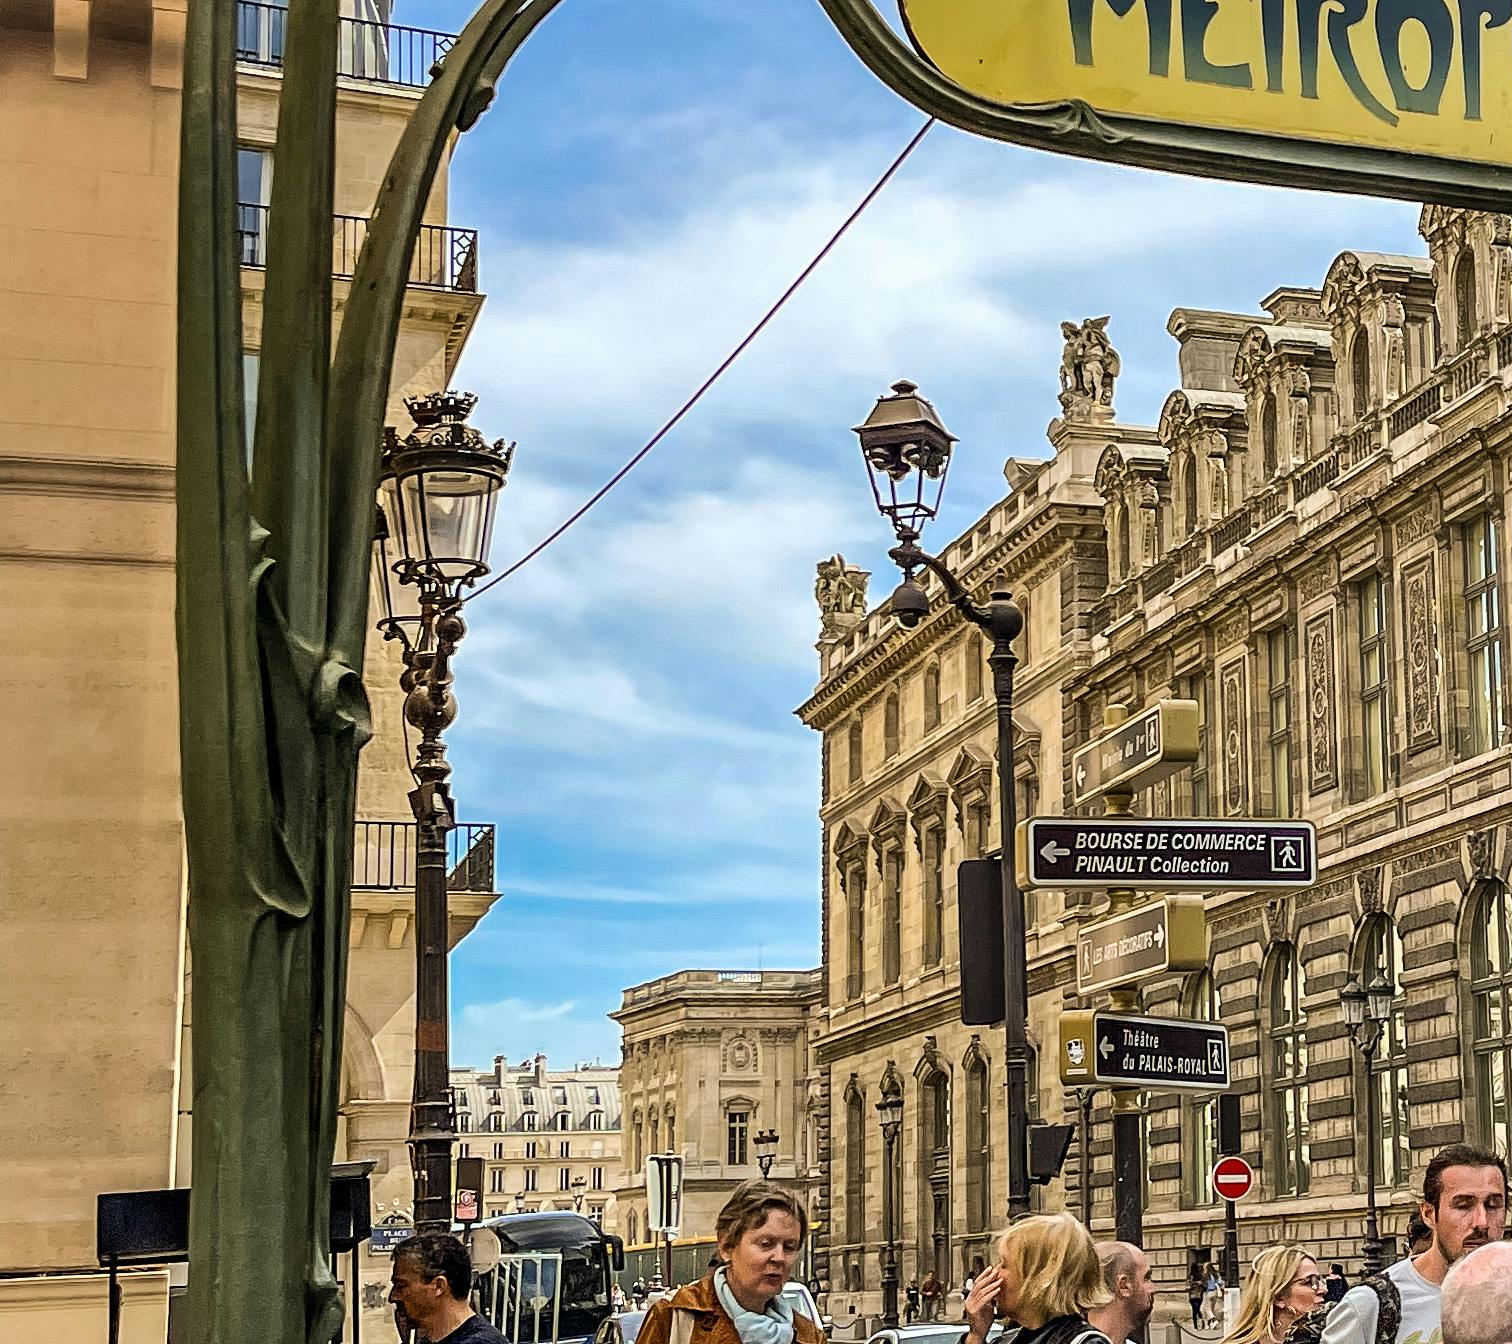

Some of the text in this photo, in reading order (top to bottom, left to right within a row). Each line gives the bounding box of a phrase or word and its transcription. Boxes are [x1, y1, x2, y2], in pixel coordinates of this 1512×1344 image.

[1075, 832, 1267, 851] BOURSE DE COMMERCE
[1075, 855, 1230, 874] PINAULT Collection
[1122, 1029, 1159, 1049] Théâtre
[1122, 1053, 1207, 1076] du PALAIS-ROYAL
